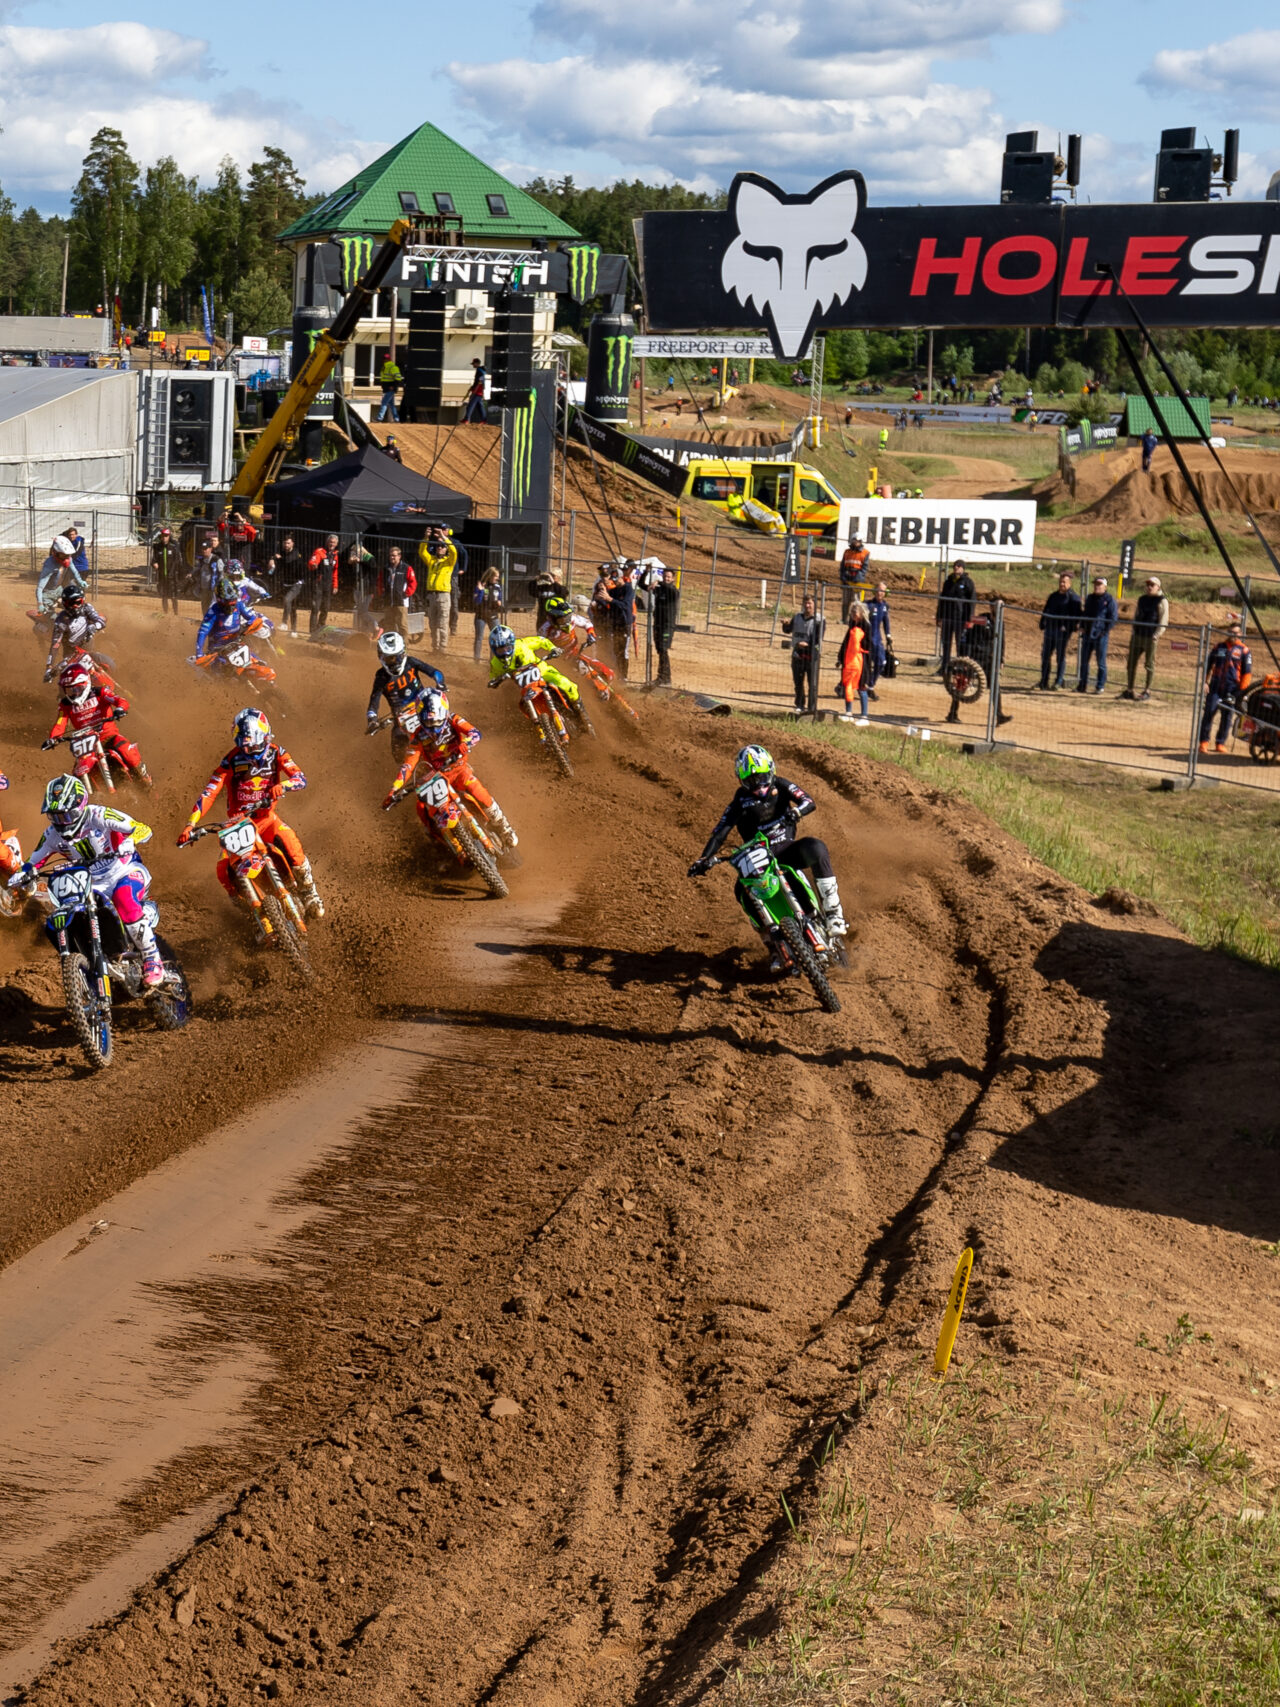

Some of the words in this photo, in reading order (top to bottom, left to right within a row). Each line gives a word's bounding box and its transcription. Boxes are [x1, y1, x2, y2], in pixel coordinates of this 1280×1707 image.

[401, 255, 548, 285] FINISH
[648, 340, 728, 354] FREEPORT
[734, 341, 761, 354] OF
[515, 666, 542, 687] 770
[72, 734, 97, 757] 517
[420, 779, 449, 807] 79
[224, 824, 256, 853] 80
[737, 847, 770, 879] 12
[51, 869, 89, 898] 198
